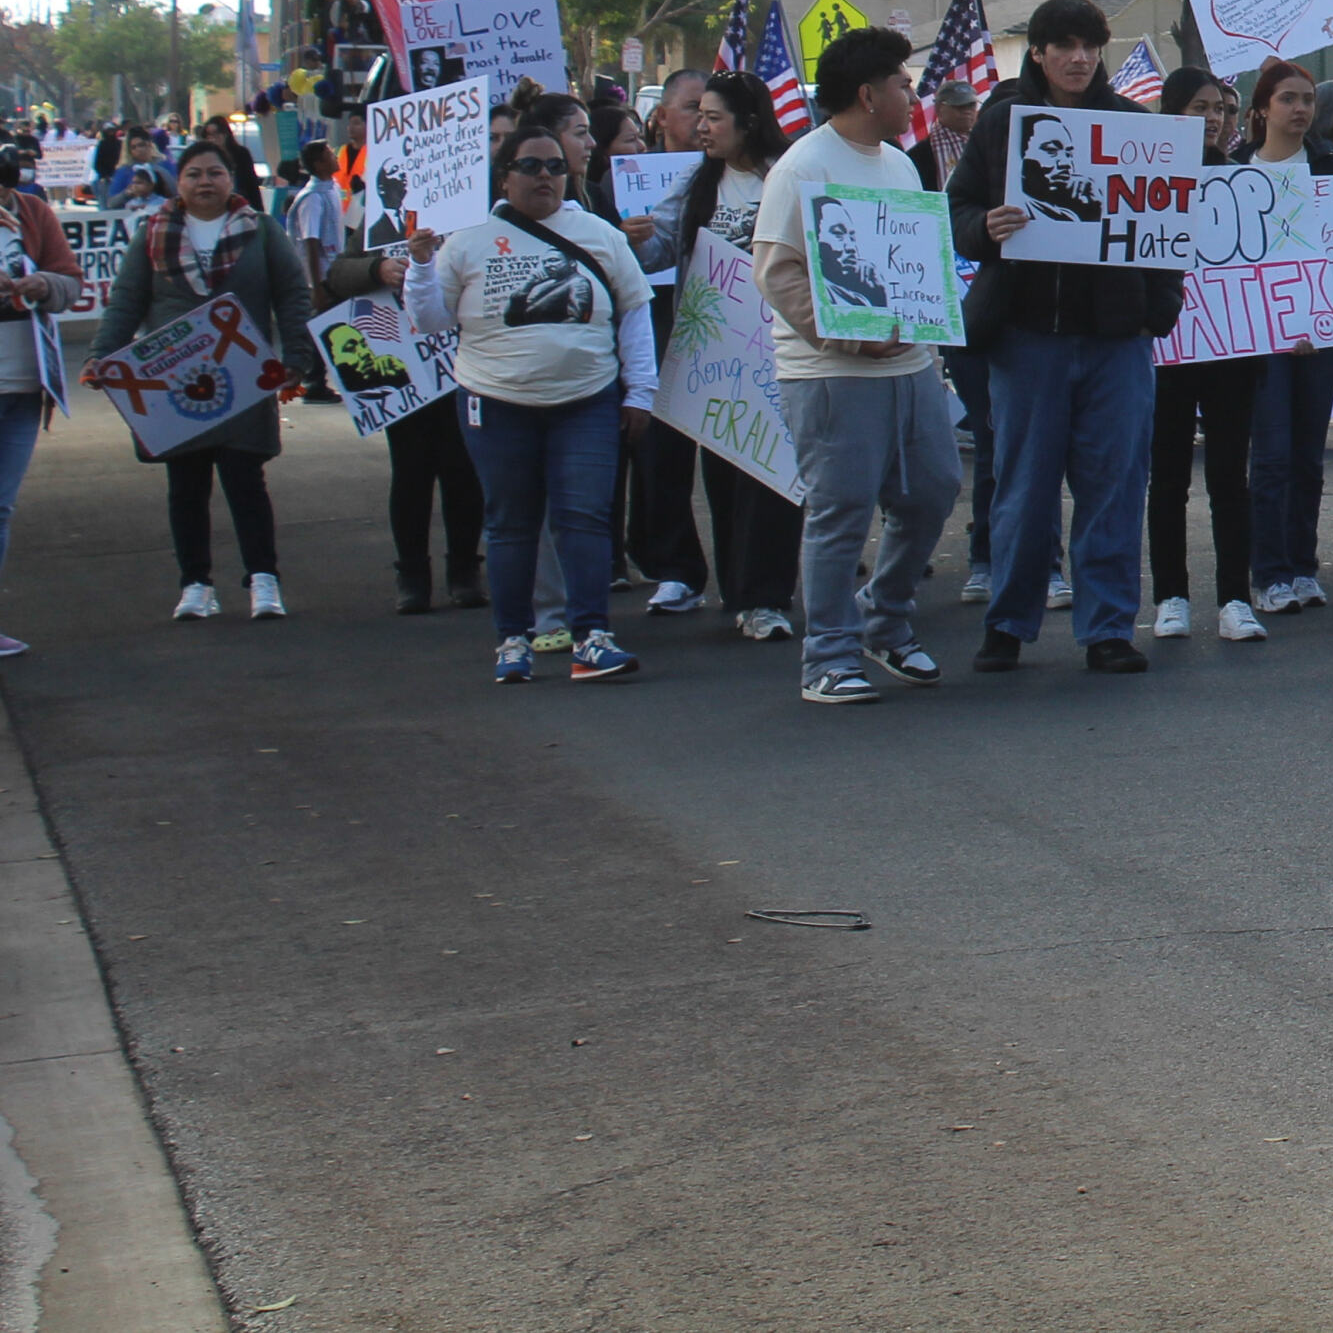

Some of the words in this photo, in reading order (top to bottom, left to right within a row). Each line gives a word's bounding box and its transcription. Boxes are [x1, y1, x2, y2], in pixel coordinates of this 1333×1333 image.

[404, 20, 454, 44] LOVE!
[411, 6, 437, 26] BE
[456, 3, 546, 37] Love
[496, 35, 529, 51] the
[511, 49, 553, 65] durable
[373, 86, 481, 144] DARKNESS
[455, 124, 484, 142] drive
[1091, 124, 1175, 166] Love
[427, 139, 481, 165] darkness
[443, 154, 468, 178] light
[423, 188, 439, 208] do
[441, 176, 473, 199] THAT
[1106, 174, 1198, 216] NOT
[876, 200, 921, 236] Honor
[1099, 218, 1191, 263] Hate
[486, 270, 531, 280] TOGETHER
[487, 264, 503, 274] TO
[508, 262, 540, 270] STAY
[708, 244, 752, 304] WE
[887, 243, 926, 285] King
[892, 306, 914, 323] the
[688, 349, 746, 399] Long
[354, 398, 397, 437] MLK
[396, 386, 428, 416] JR.
[701, 398, 747, 452] FOR
[740, 410, 782, 475] ALL
